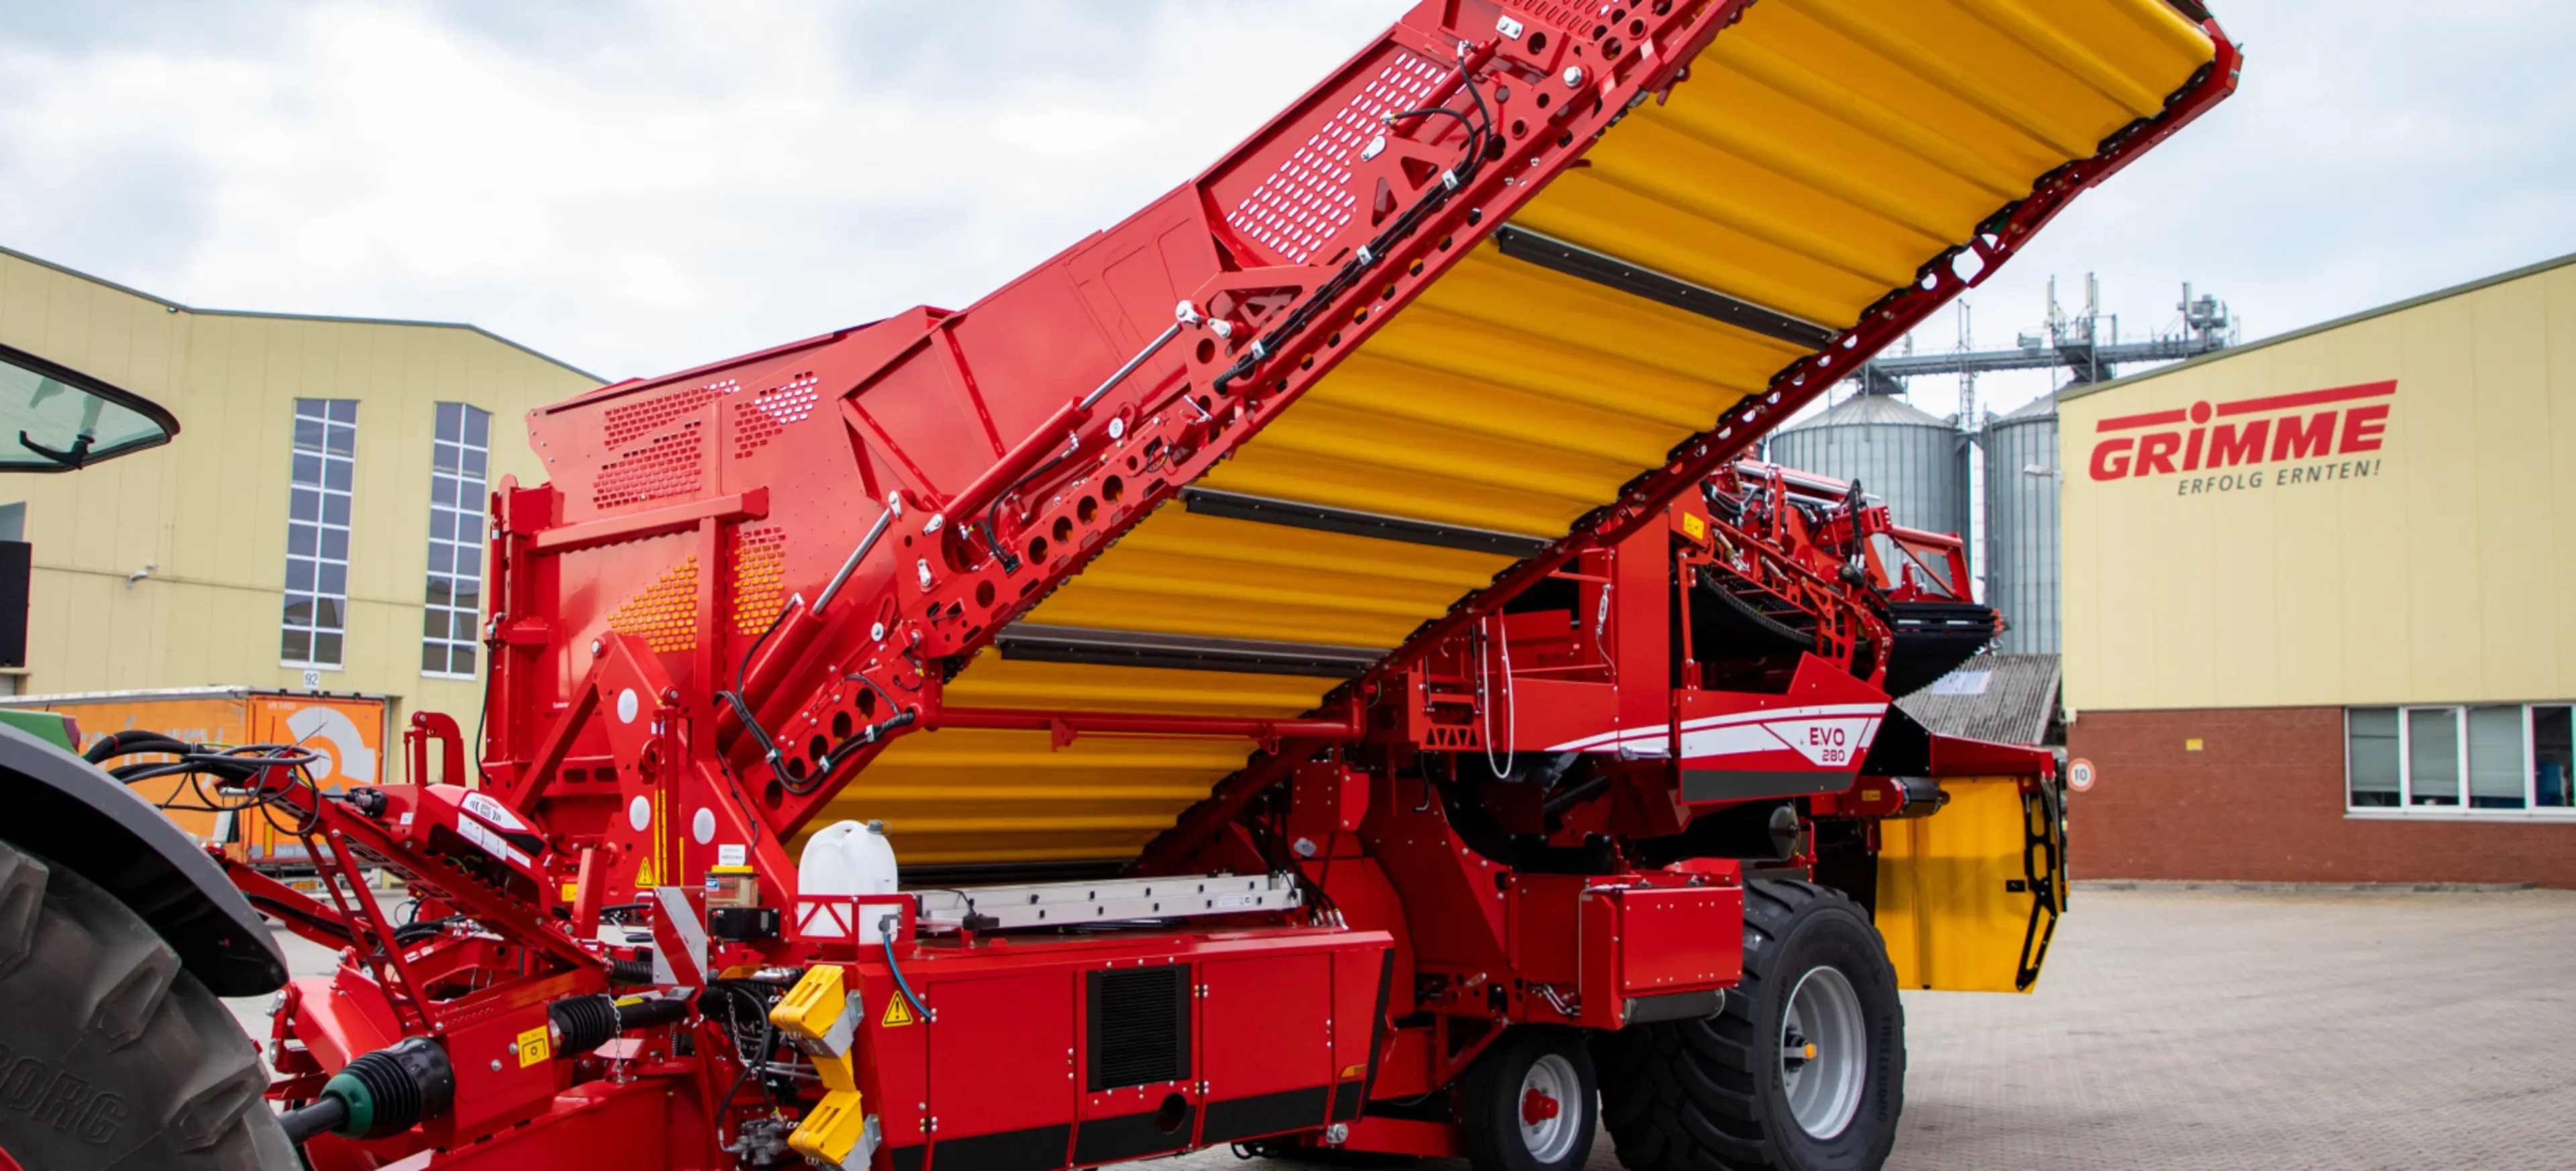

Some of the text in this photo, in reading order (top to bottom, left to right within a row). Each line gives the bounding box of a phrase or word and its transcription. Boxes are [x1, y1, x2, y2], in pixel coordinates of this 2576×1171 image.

[2089, 400, 2390, 482] GRIMME
[2178, 459, 2381, 496] ERFOLG ERNTEN!
[305, 672, 319, 686] 92
[1809, 727, 1845, 747] EVO
[1821, 749, 1845, 762] 280
[2074, 768, 2088, 781] 10
